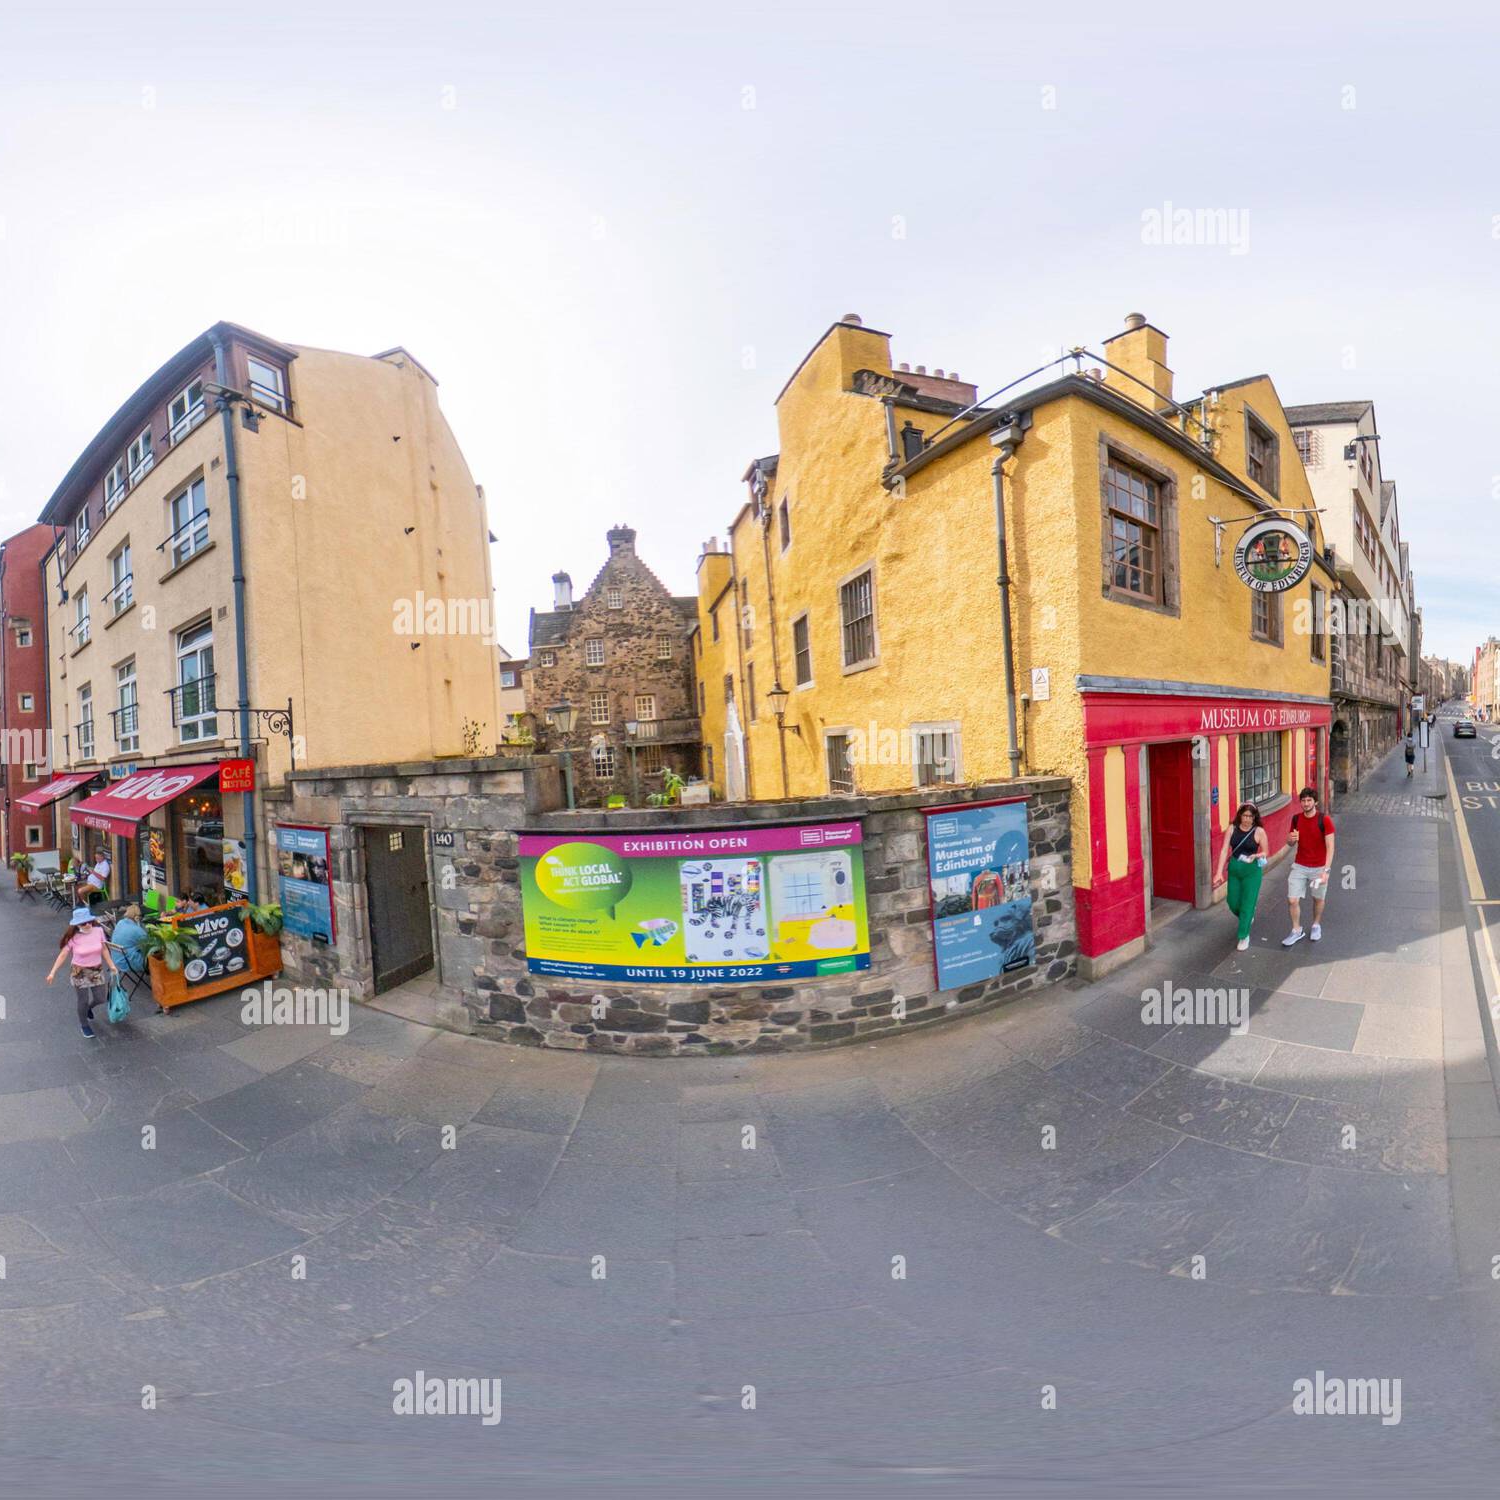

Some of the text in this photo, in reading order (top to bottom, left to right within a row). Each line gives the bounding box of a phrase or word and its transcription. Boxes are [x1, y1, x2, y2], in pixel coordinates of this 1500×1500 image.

[1235, 541, 1311, 590] MUSEUM OF EDINBURGH
[1200, 708, 1311, 729] MUSEUM OF EDINBURGH
[222, 765, 251, 779] CAFÉ
[222, 780, 252, 789] BISTRO
[435, 834, 452, 845] 140
[623, 837, 748, 852] EXHIBITION OPEN
[935, 840, 997, 861] Museum of
[550, 863, 613, 877] THINK LOCAL
[936, 853, 993, 873] Edinburgh
[563, 877, 580, 888] ACT
[194, 917, 229, 935] VIVO
[626, 967, 763, 980] UNTIL 19 JUNE 2022
